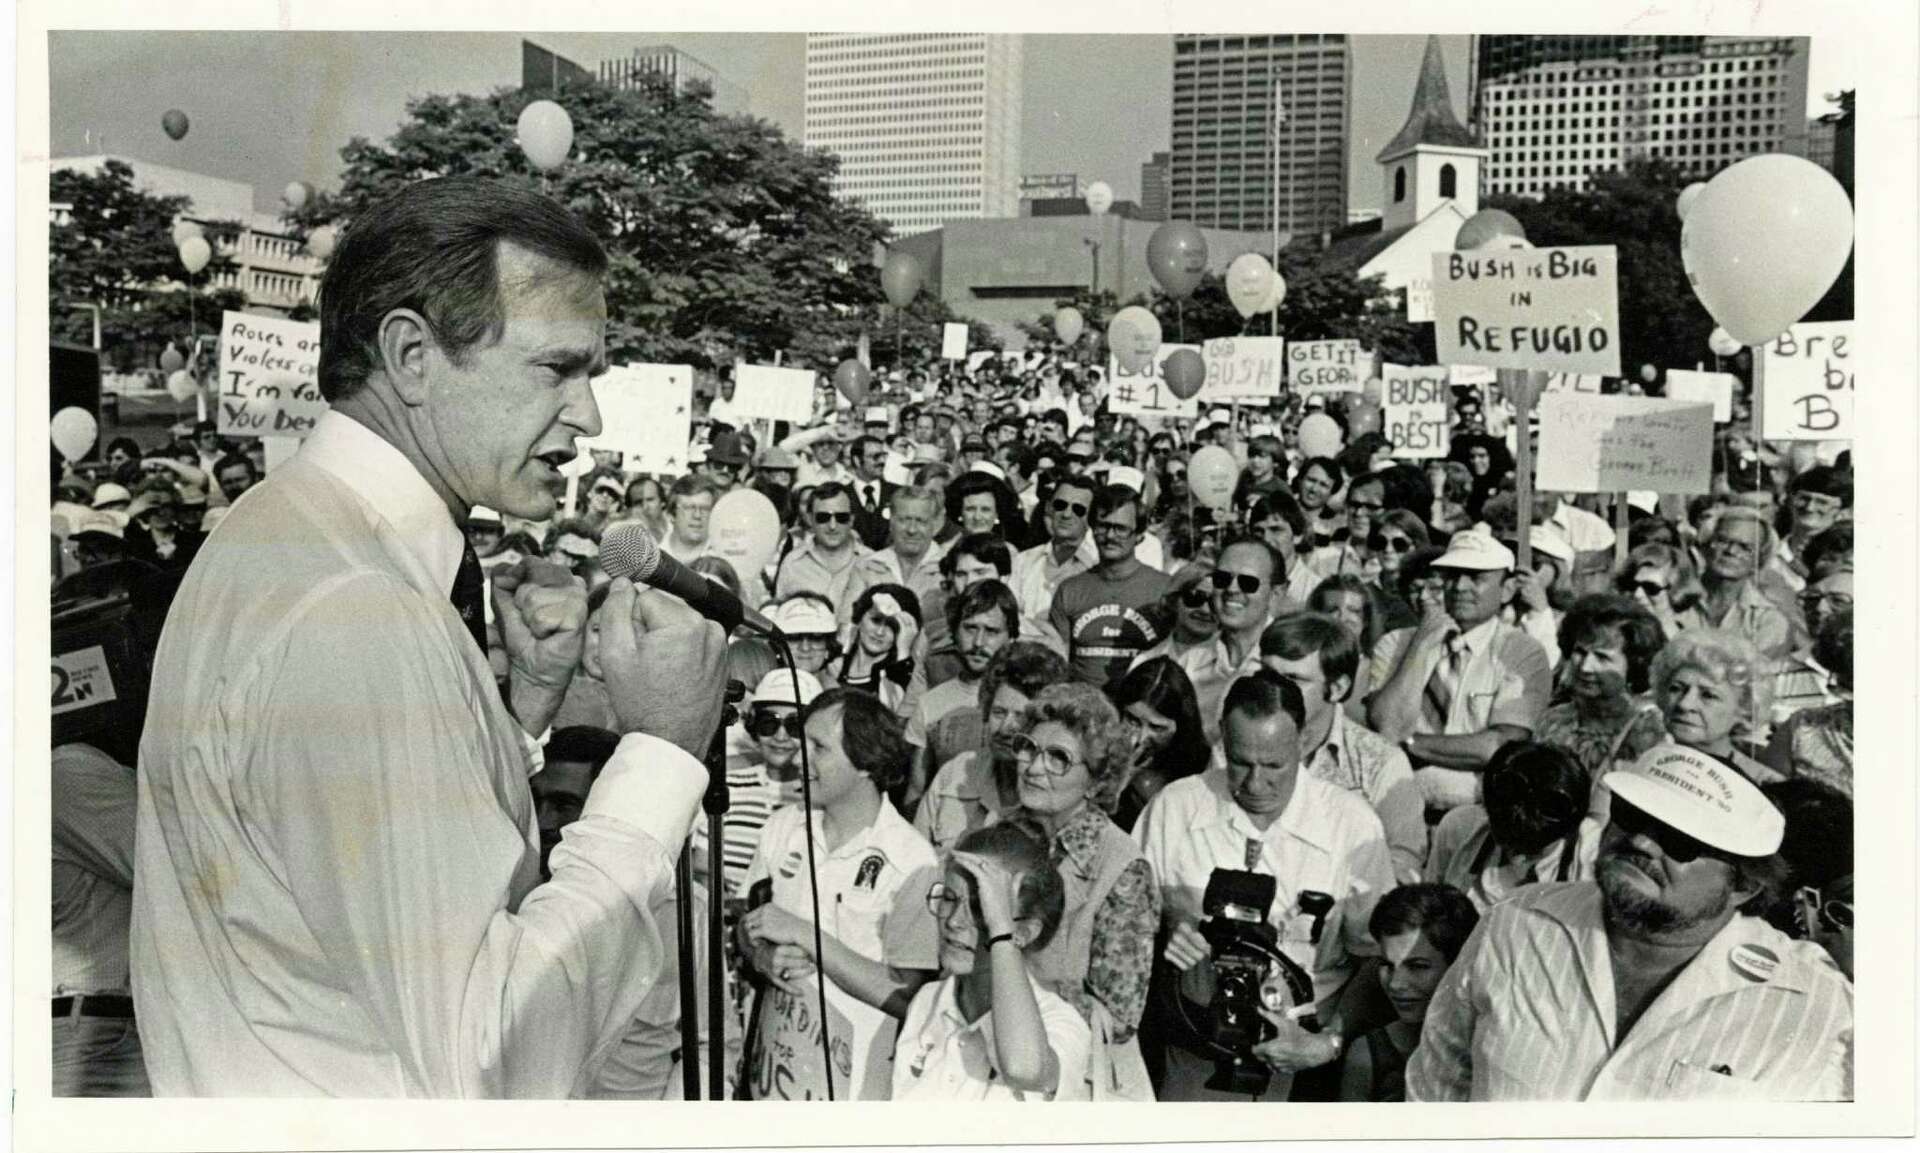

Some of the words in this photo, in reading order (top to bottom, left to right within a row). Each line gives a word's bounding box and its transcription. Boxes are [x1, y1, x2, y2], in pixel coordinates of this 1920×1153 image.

[1450, 253, 1514, 280] BUSH
[1549, 250, 1597, 279] BIG
[1510, 291, 1531, 306] IN
[1459, 315, 1608, 354] REFUGIO
[1773, 329, 1849, 359] Bre
[1290, 343, 1335, 361] GET
[1207, 359, 1275, 389] BUSH
[1389, 378, 1444, 405] BUSH
[223, 401, 266, 428] You
[1391, 421, 1441, 449] BEST
[1656, 754, 1704, 770] GEORGE
